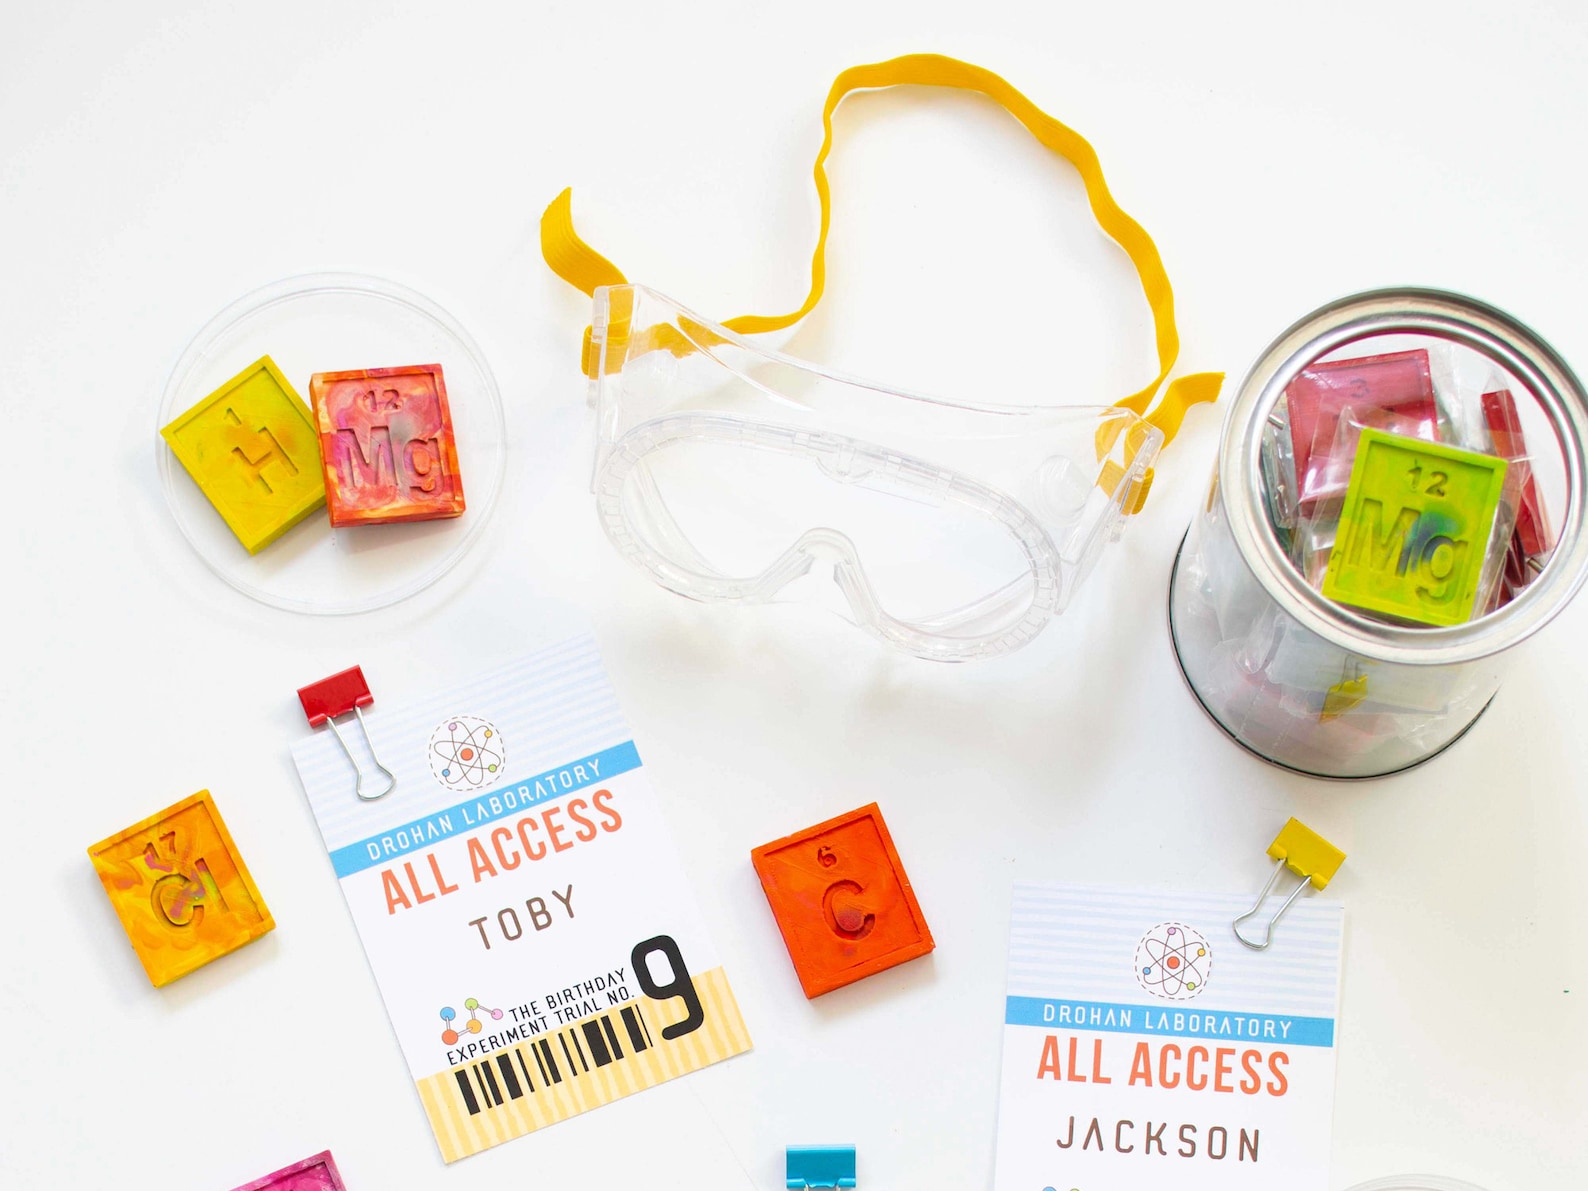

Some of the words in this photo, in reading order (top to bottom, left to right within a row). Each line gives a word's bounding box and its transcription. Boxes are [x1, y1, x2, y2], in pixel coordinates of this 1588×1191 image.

[231, 426, 298, 494] H
[336, 425, 445, 497] Mg
[1408, 463, 1449, 497] 12
[1348, 498, 1469, 606] Mg
[367, 815, 453, 861] DROHAN
[461, 759, 602, 826] LABORATORY
[143, 831, 176, 861] 17
[381, 852, 459, 914] ALL
[466, 789, 623, 882] ACCESS
[817, 845, 838, 868] 6
[469, 884, 575, 949] TOBY
[822, 878, 876, 941] C
[509, 1002, 541, 1022] THE
[546, 969, 626, 1008] BIRTHDAY
[631, 935, 704, 1040] 9
[446, 1015, 549, 1065] EXPERIMENT
[553, 999, 602, 1025] TRIAL
[607, 988, 634, 1008] NO.
[1044, 1004, 1131, 1027] DROHAN
[1145, 1010, 1292, 1039] LABORATORY
[1036, 1035, 1111, 1084] ALL
[1128, 1042, 1288, 1096] ACCESS
[1056, 1116, 1259, 1162] JACKSON
